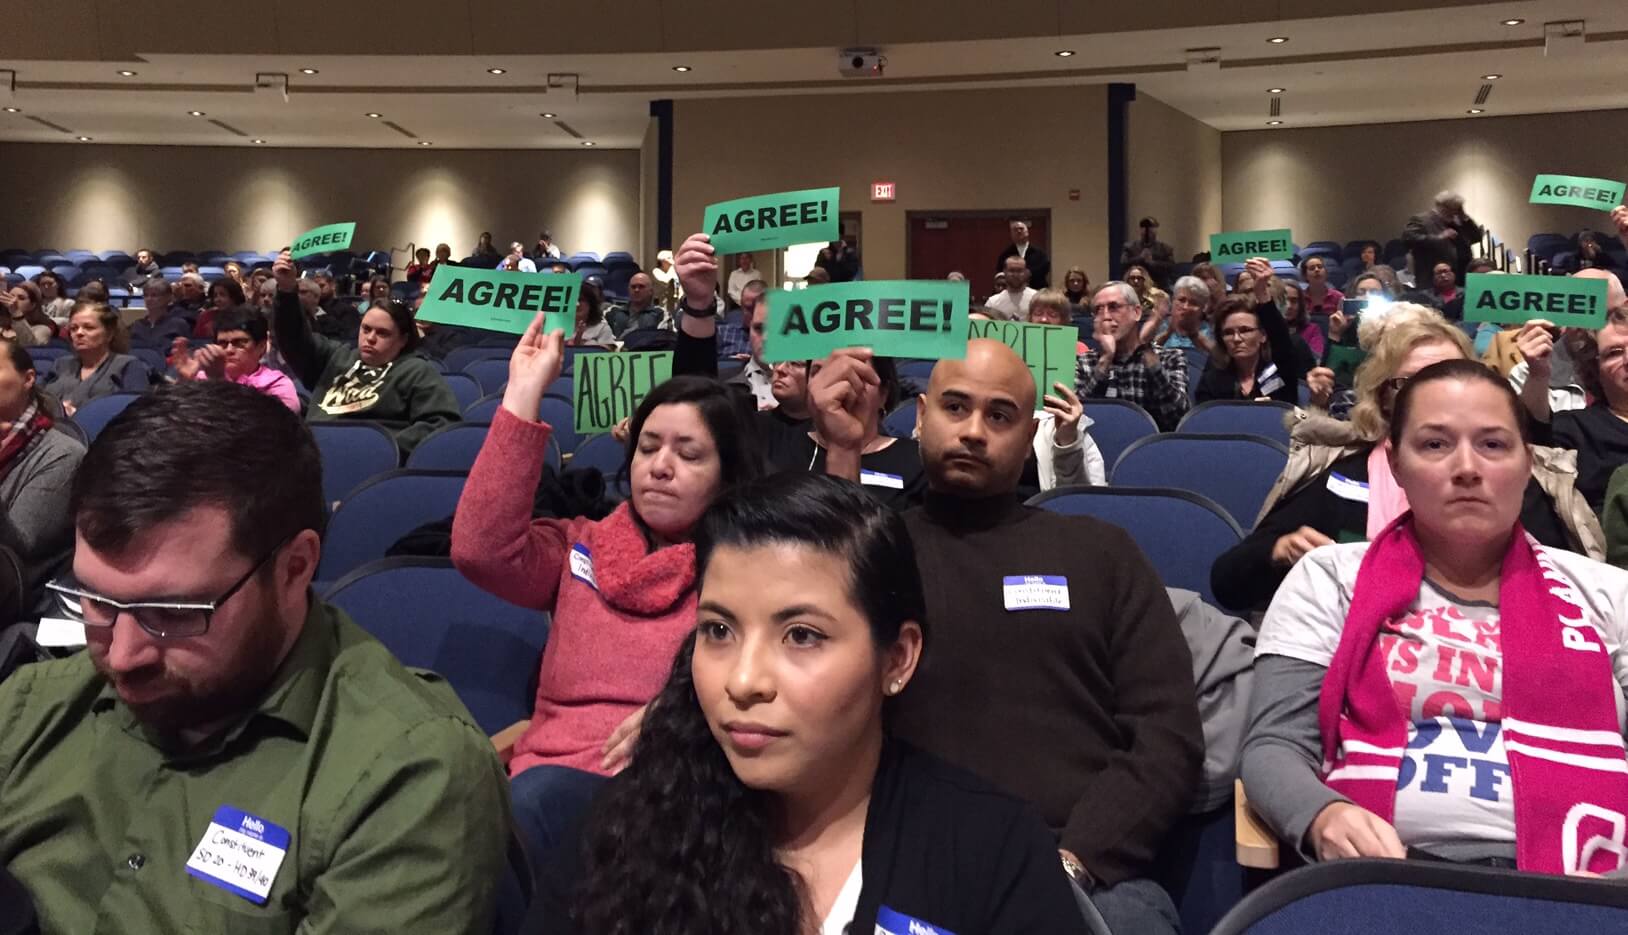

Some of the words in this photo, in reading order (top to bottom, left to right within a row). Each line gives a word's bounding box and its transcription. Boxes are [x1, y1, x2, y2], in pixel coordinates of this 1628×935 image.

[875, 184, 892, 198] EXIT
[1538, 184, 1617, 204] AGREE!
[712, 200, 829, 235] AGREE!
[292, 232, 348, 252] AGREE!
[1218, 239, 1287, 256] AGREE!
[439, 278, 573, 312] AGREE!
[1476, 290, 1597, 315] AGREE!
[781, 299, 953, 336] AGREE!
[1433, 645, 1498, 693] IN
[242, 816, 265, 833] Hello
